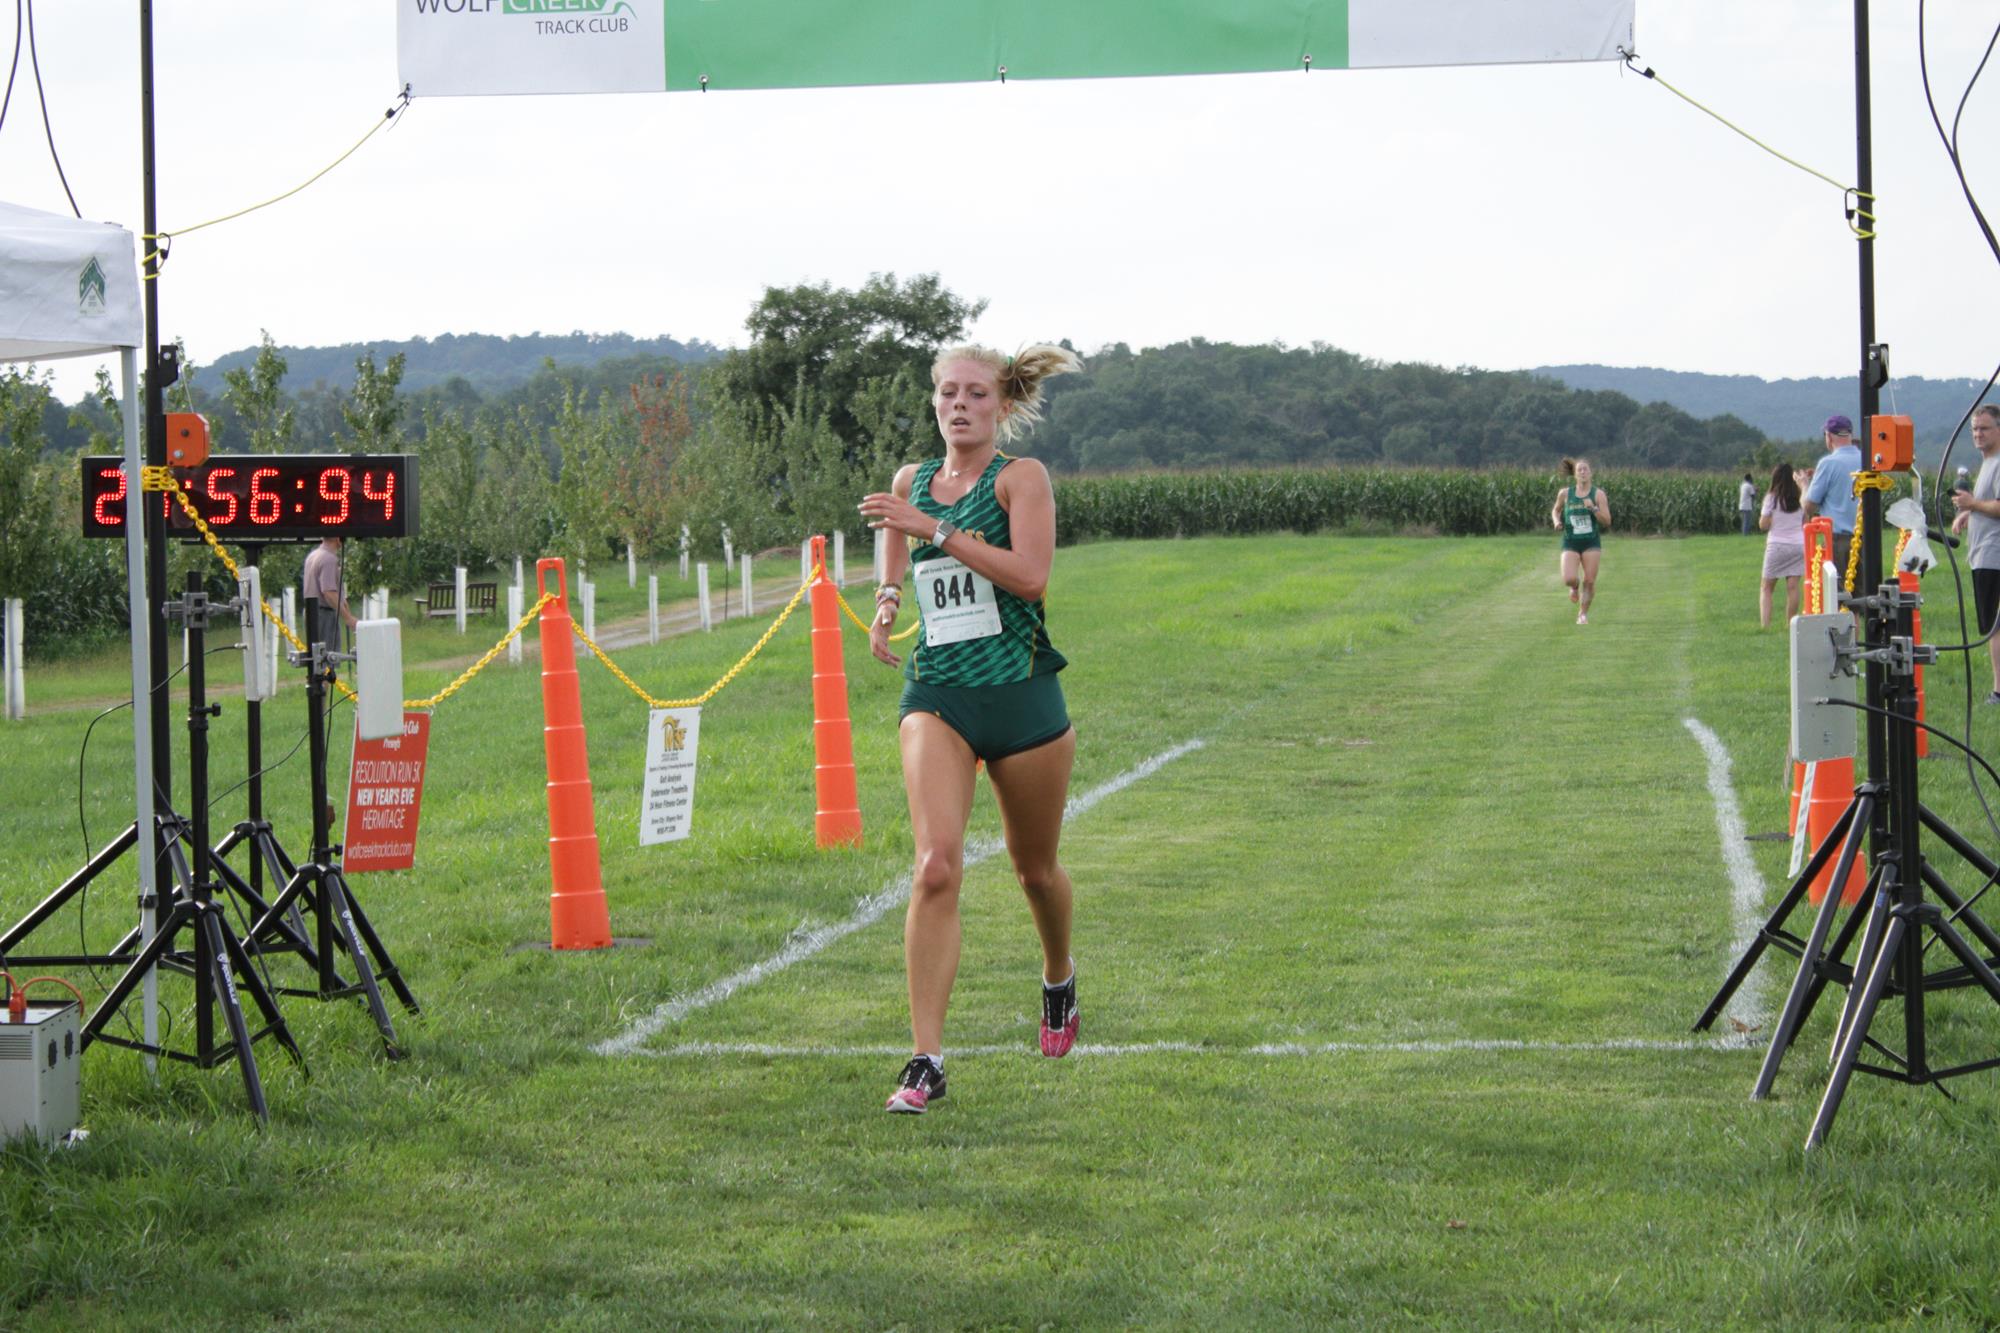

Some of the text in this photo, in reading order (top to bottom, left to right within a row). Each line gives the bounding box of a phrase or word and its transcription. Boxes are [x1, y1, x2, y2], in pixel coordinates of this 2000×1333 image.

[416, 0, 498, 13] WOLF
[536, 17, 629, 35] TRACK CLUB
[932, 572, 977, 610] 844
[355, 760, 422, 784] RESOLUTION RUN 5K
[356, 787, 415, 807] NEW YEAR'S EVE
[362, 809, 406, 830] HERMITAGE
